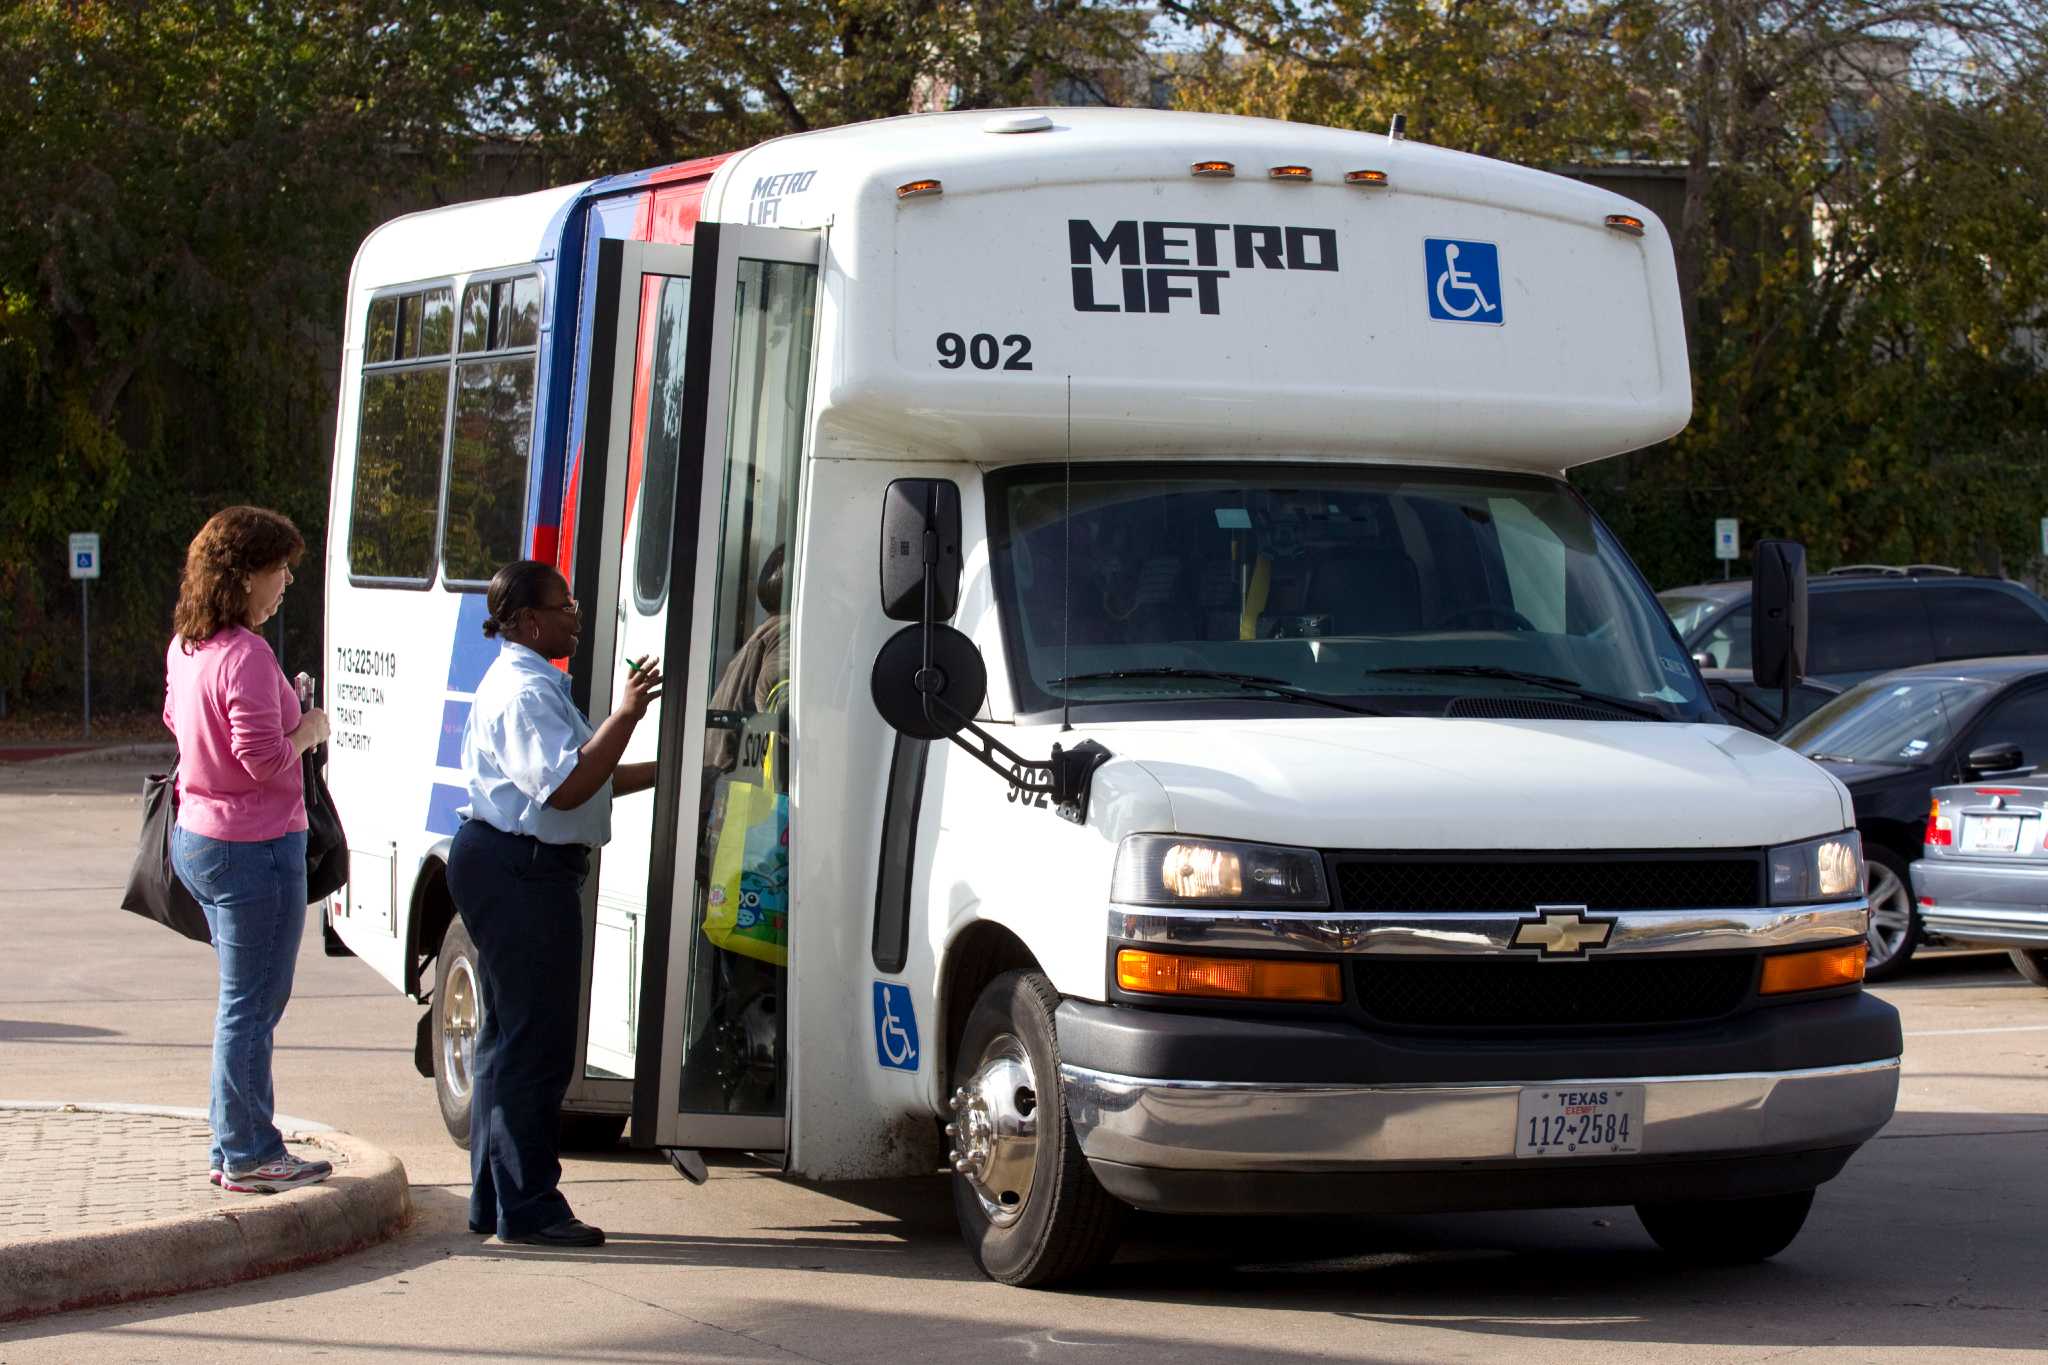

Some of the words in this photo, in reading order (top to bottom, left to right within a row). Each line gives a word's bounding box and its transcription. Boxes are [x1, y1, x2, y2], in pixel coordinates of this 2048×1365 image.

[751, 169, 818, 201] METRO
[748, 198, 782, 226] LIFT
[1068, 219, 1339, 272] METRO
[1071, 266, 1231, 315] LIFT
[936, 332, 1033, 371] 902
[337, 647, 396, 678] 713-225-0119
[337, 683, 385, 705] METROPOLITAN
[336, 707, 363, 726] TRANSIT
[336, 731, 371, 752] AUTHORITY
[1007, 762, 1054, 809] 902
[1558, 1091, 1608, 1106] TEXAS
[1528, 1115, 1566, 1147] 112
[1577, 1113, 1629, 1145] 2584
